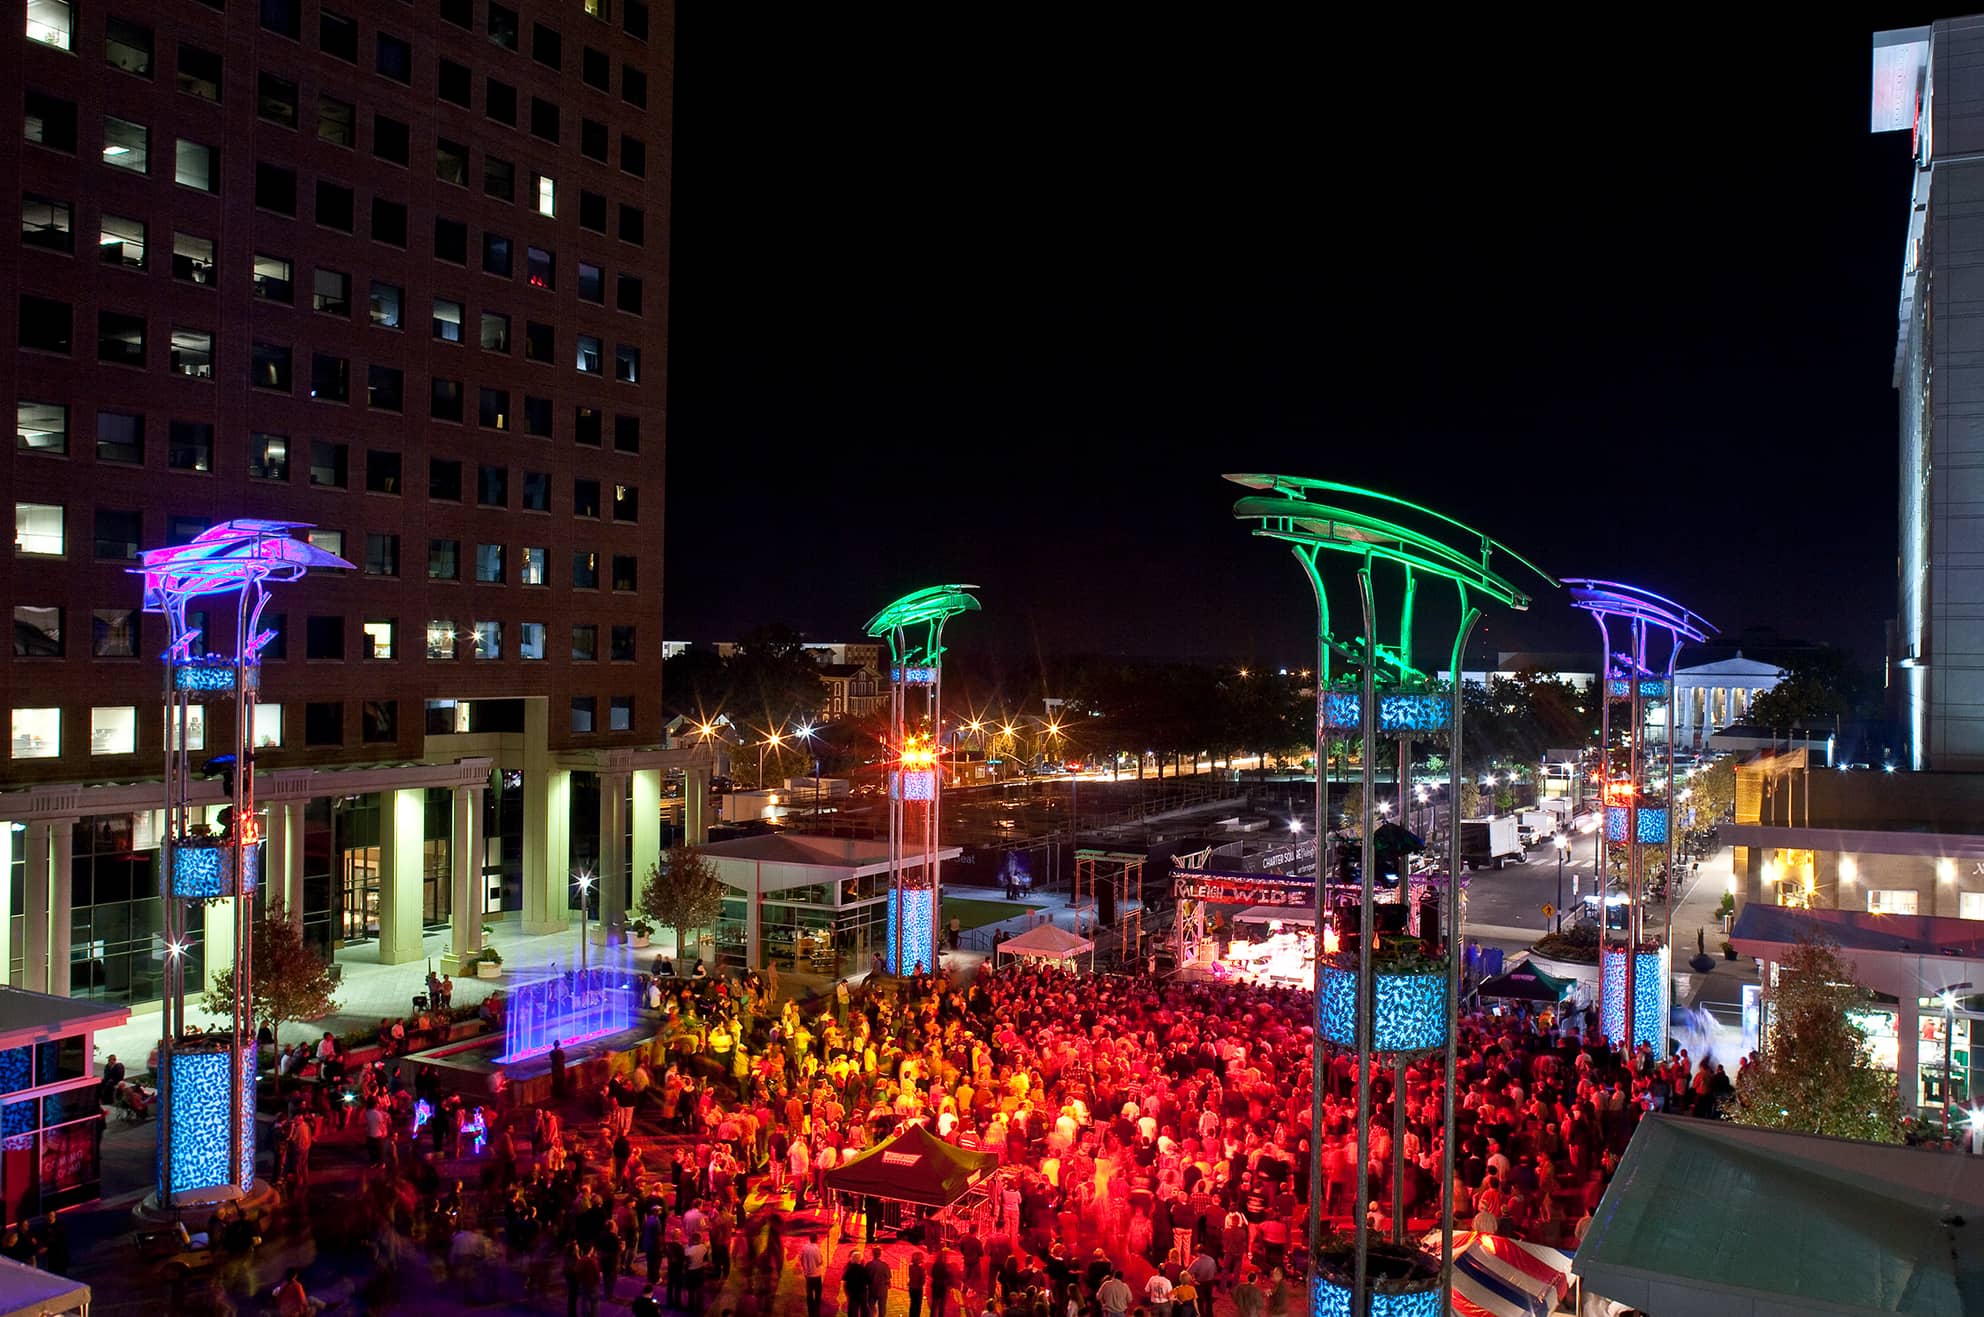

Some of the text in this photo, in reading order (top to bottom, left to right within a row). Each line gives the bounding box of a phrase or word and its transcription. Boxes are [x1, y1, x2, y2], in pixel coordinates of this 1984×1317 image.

[1263, 852, 1284, 869] CHARTER
[1283, 848, 1302, 864] SQURE
[1174, 878, 1224, 899] RALEIGH
[1233, 888, 1307, 905] WIDE
